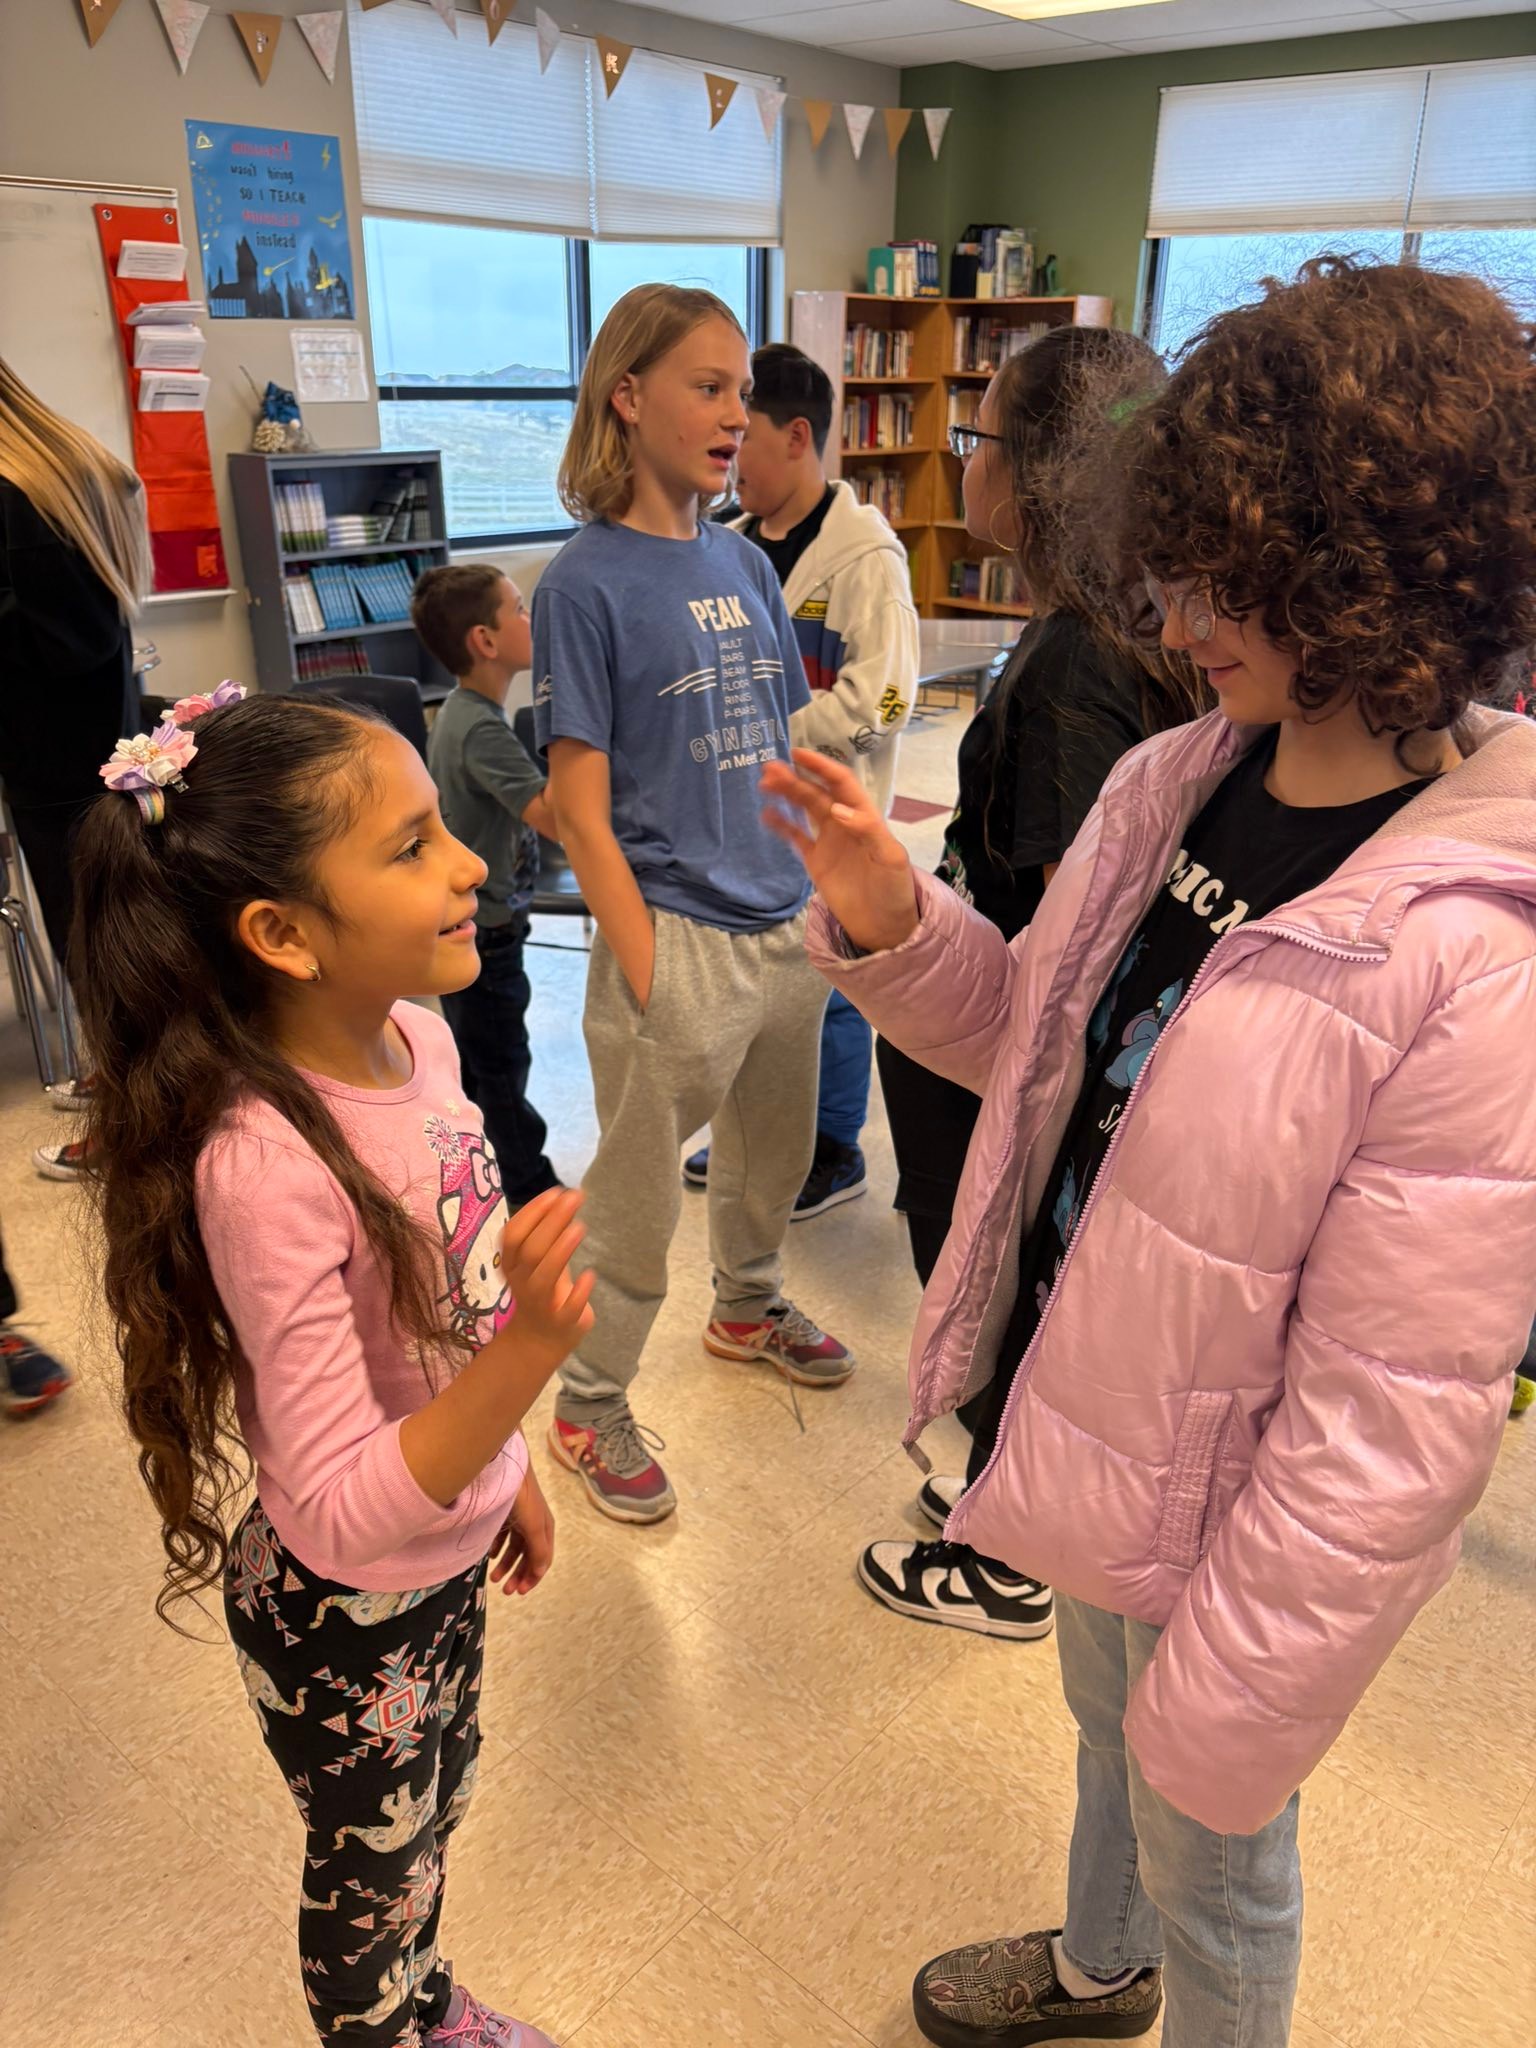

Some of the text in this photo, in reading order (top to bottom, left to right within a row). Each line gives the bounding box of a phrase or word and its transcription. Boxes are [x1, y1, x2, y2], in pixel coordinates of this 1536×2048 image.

[688, 595, 752, 632] PEAK
[720, 652, 746, 665] BARS
[721, 665, 747, 679] BEAM
[721, 679, 751, 692] FLOOR
